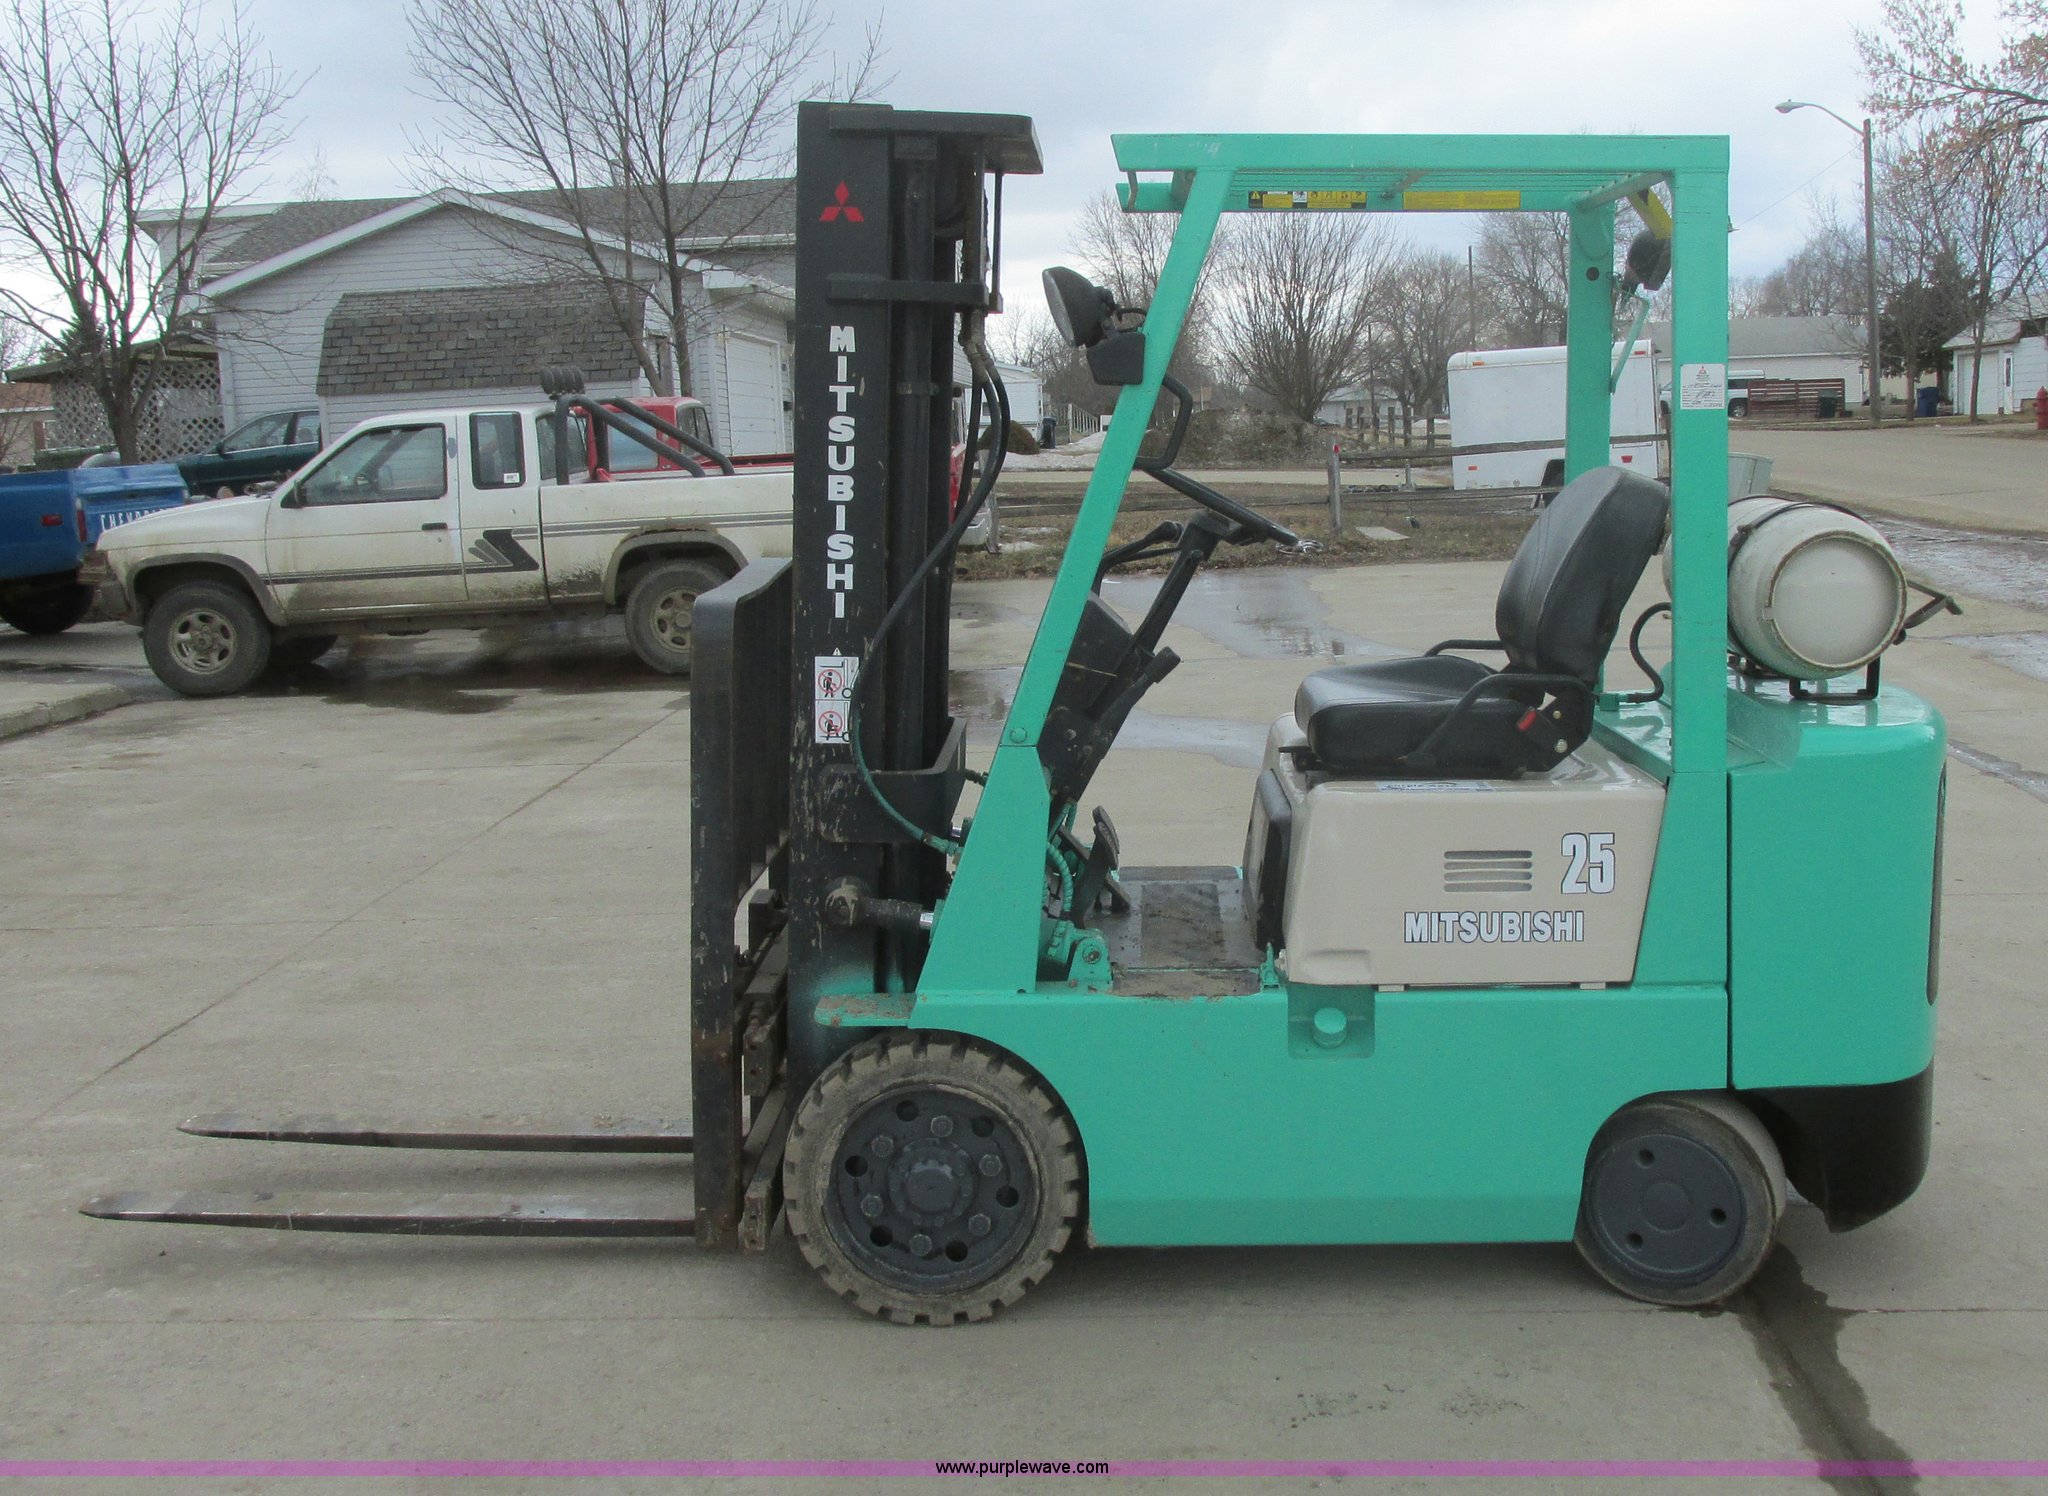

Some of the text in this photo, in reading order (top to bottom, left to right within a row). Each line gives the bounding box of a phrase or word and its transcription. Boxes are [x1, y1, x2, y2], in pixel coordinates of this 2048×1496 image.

[826, 325, 857, 618] MITSUBISHI
[1560, 832, 1616, 895] 25
[1403, 910, 1586, 944] MITSUBISHI
